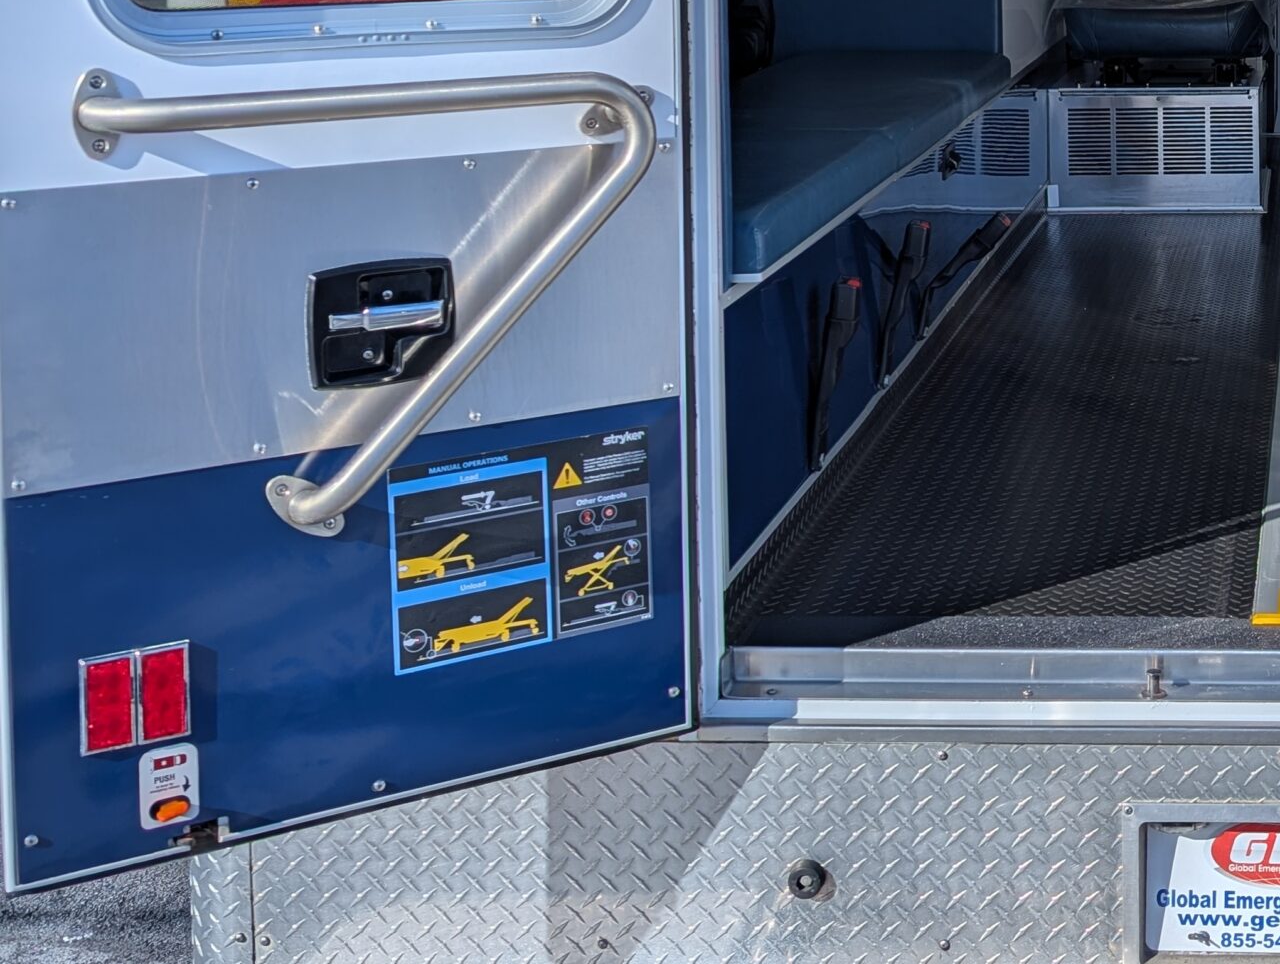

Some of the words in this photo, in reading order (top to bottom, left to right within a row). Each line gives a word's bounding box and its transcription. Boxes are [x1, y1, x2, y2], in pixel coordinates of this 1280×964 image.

[602, 430, 645, 446] stryker
[428, 464, 461, 474] MANUAL
[462, 455, 509, 468] OPERATIONS
[459, 473, 479, 482] Load
[576, 497, 596, 506] Other
[597, 492, 627, 502] Controls
[460, 580, 486, 591] Unload
[154, 774, 175, 784] PUSH
[1228, 864, 1256, 872] Global
[1156, 889, 1216, 908] Global
